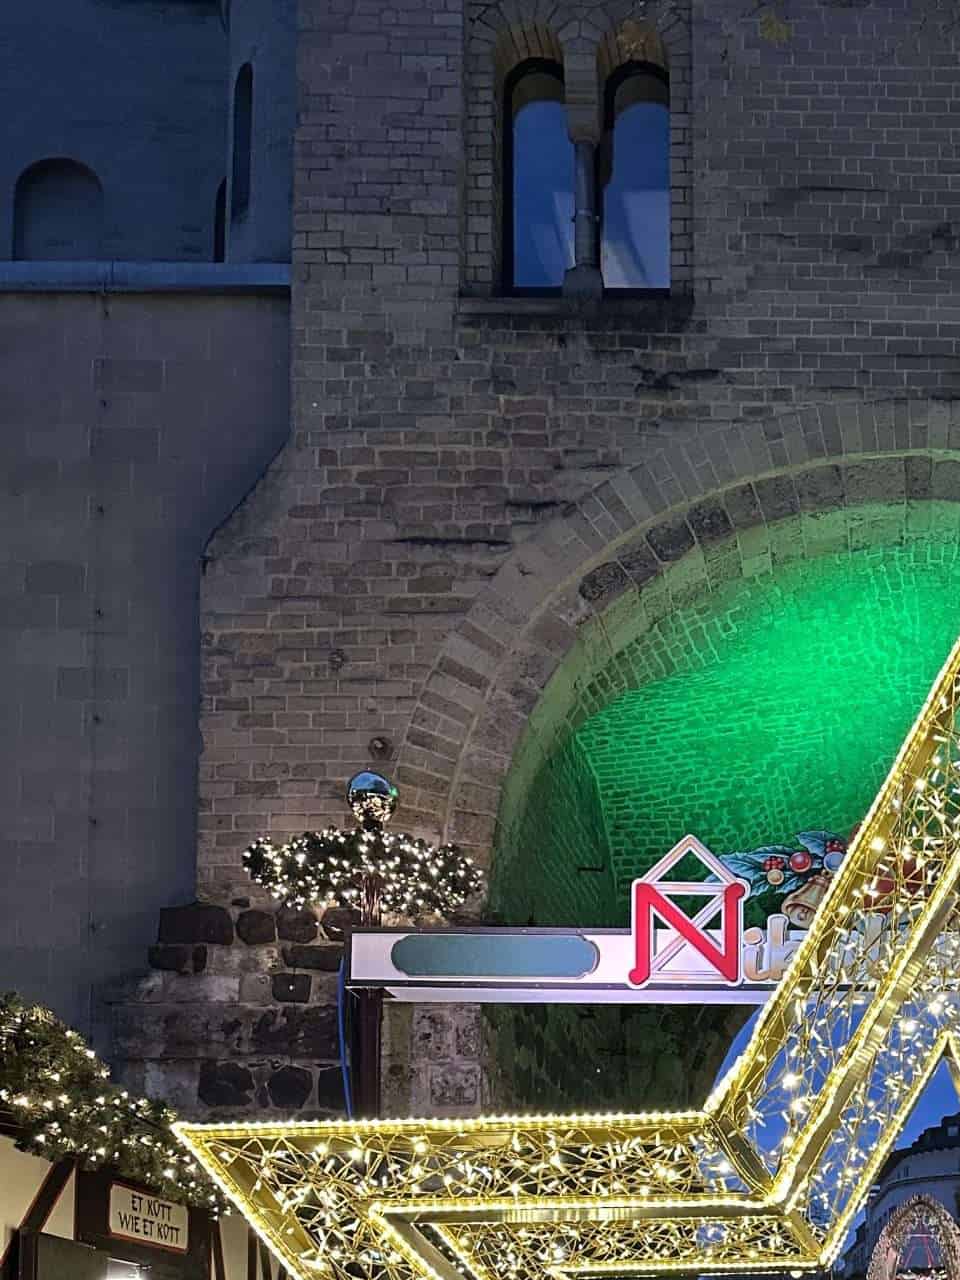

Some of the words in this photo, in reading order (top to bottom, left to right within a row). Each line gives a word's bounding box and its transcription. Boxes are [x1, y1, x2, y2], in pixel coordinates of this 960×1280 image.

[131, 1194, 144, 1213] ET
[118, 1211, 140, 1233] WIE
[143, 1219, 155, 1237] ET
